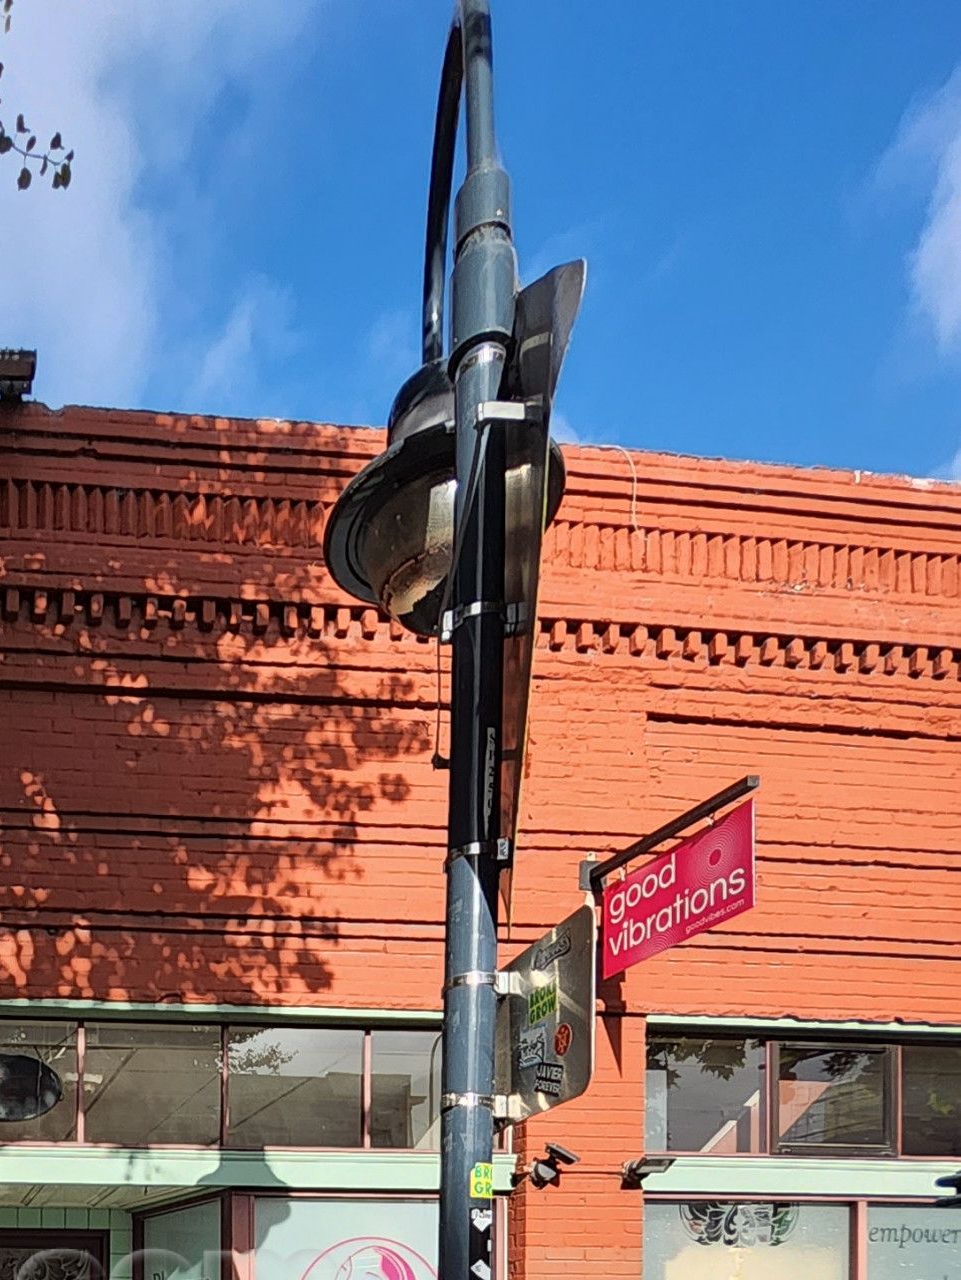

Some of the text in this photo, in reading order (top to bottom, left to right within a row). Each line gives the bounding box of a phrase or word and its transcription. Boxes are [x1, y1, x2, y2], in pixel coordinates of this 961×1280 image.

[609, 853, 676, 924] good
[609, 867, 746, 956] vibrations
[685, 899, 745, 935] goodvibes.com
